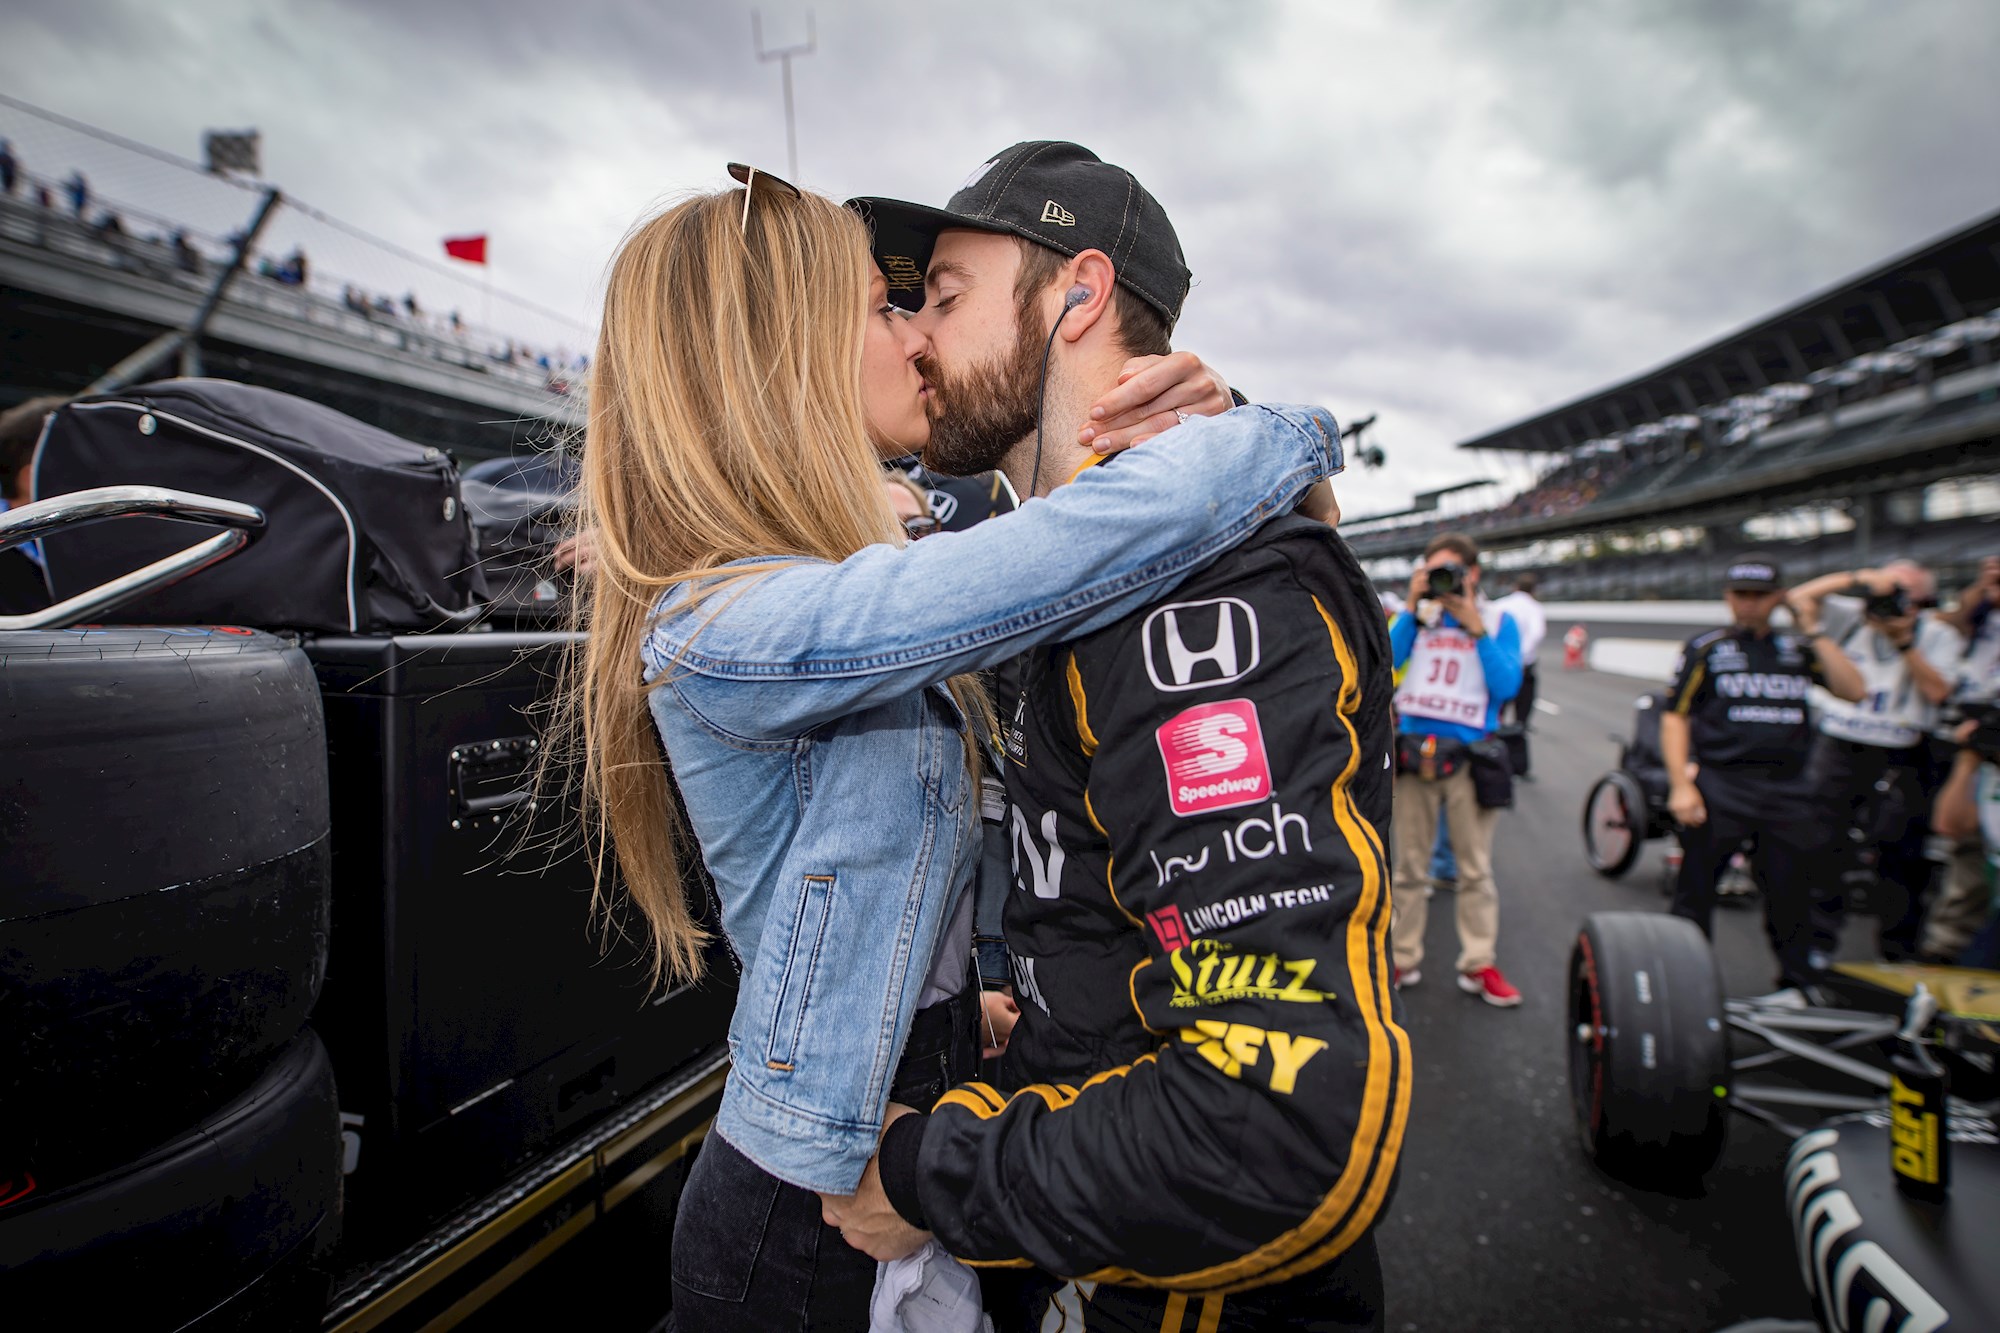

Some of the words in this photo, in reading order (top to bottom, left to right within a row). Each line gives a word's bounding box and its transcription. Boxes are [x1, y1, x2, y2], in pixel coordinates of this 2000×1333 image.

[1178, 775, 1262, 804] Speedway
[1184, 894, 1267, 935] LINCOLN
[1270, 884, 1331, 909] TECH
[1891, 1073, 1925, 1182] DEFY
